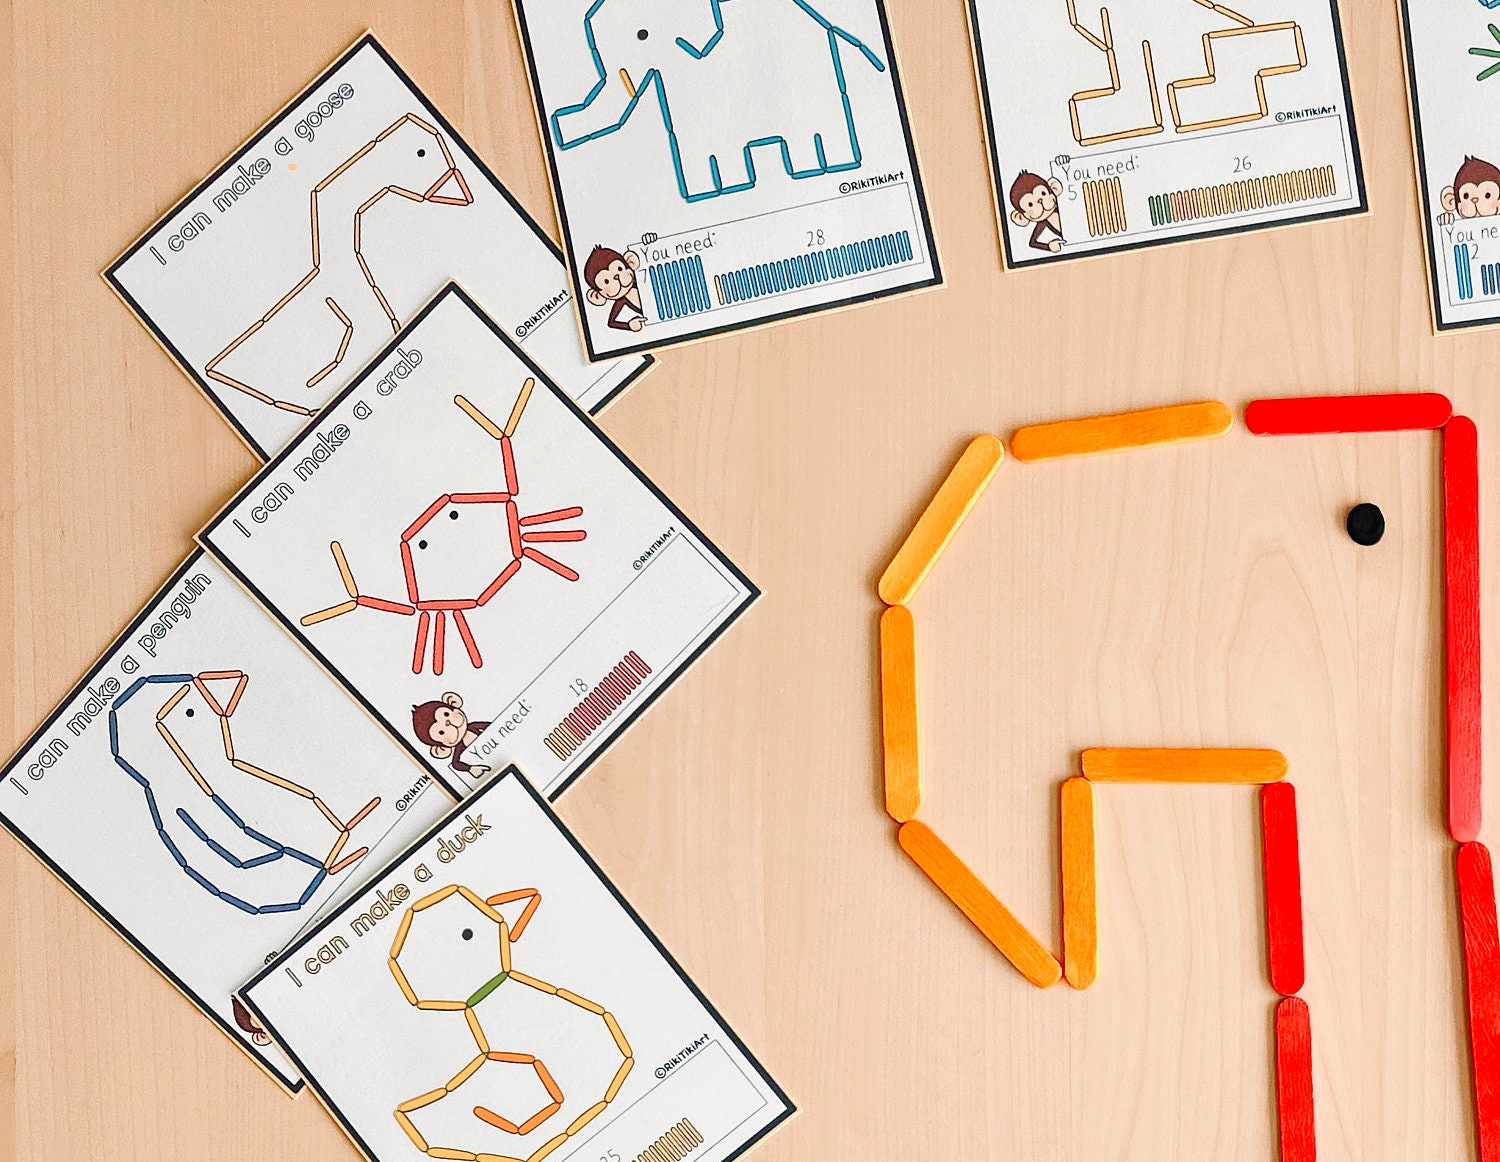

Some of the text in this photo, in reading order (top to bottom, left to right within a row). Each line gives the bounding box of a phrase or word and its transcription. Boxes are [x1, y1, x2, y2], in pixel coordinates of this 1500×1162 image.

[150, 83, 354, 265] I can make a goose
[1062, 155, 1139, 182] You need:
[1233, 156, 1252, 173] 26
[1068, 185, 1077, 201] 5
[806, 229, 825, 247] 28
[1444, 225, 1475, 244] You
[640, 233, 717, 262] You need:
[1471, 244, 1480, 260] 2
[639, 268, 648, 284] 7
[233, 348, 422, 538] I can make a crab
[10, 573, 211, 795] I can make a penguin
[569, 677, 589, 698] 18
[468, 699, 532, 761] You need:
[285, 814, 492, 987] I can make a duck
